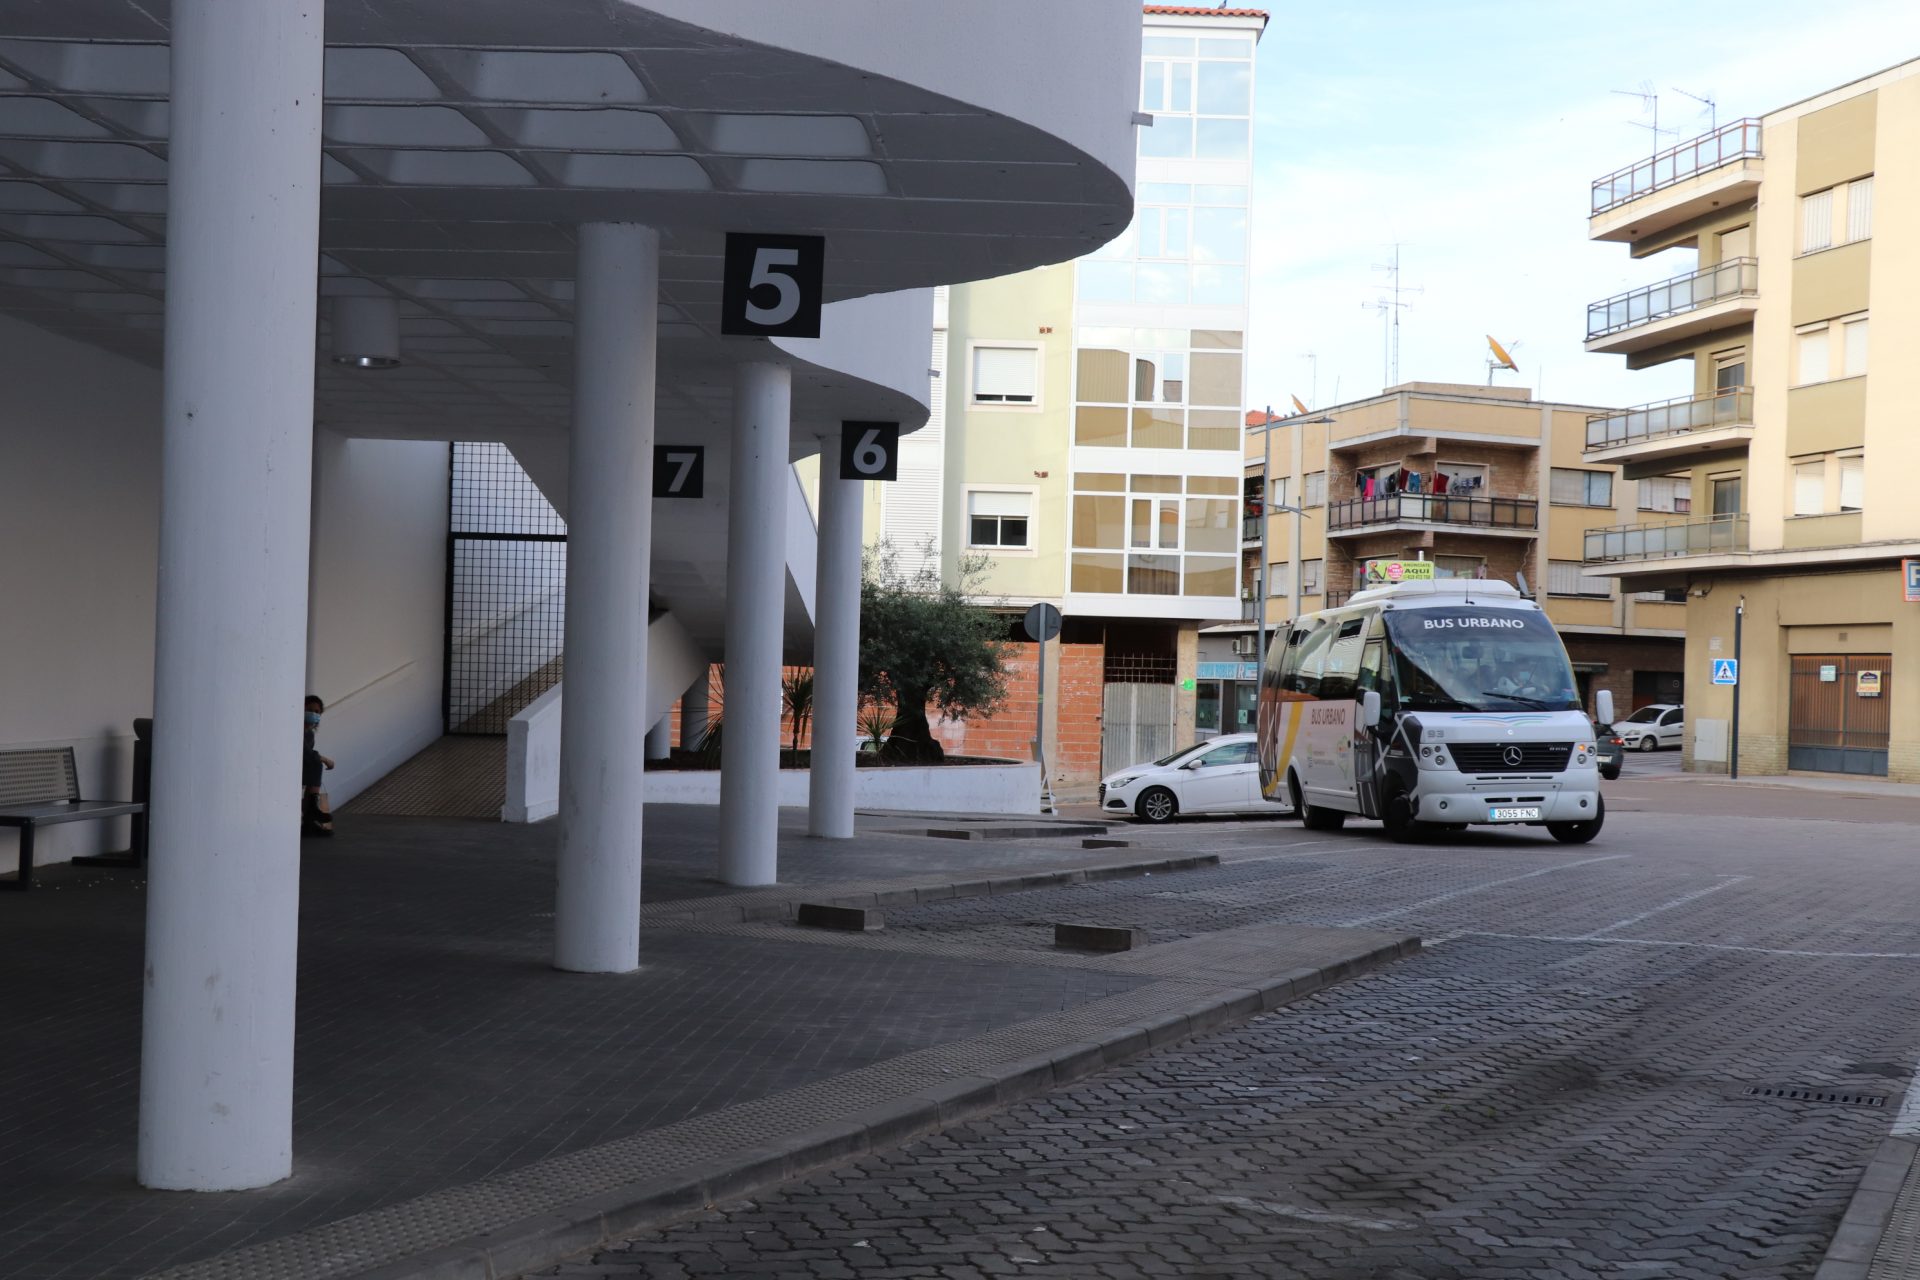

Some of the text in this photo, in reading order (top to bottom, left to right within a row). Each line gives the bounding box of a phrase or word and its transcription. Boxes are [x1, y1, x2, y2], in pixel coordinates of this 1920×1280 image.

[745, 247, 800, 326] 5
[853, 429, 887, 474] 6
[666, 453, 697, 492] 7
[1423, 618, 1525, 630] BUS URBANO
[1311, 708, 1345, 725] BUS URBANO
[1497, 809, 1518, 818] 3055
